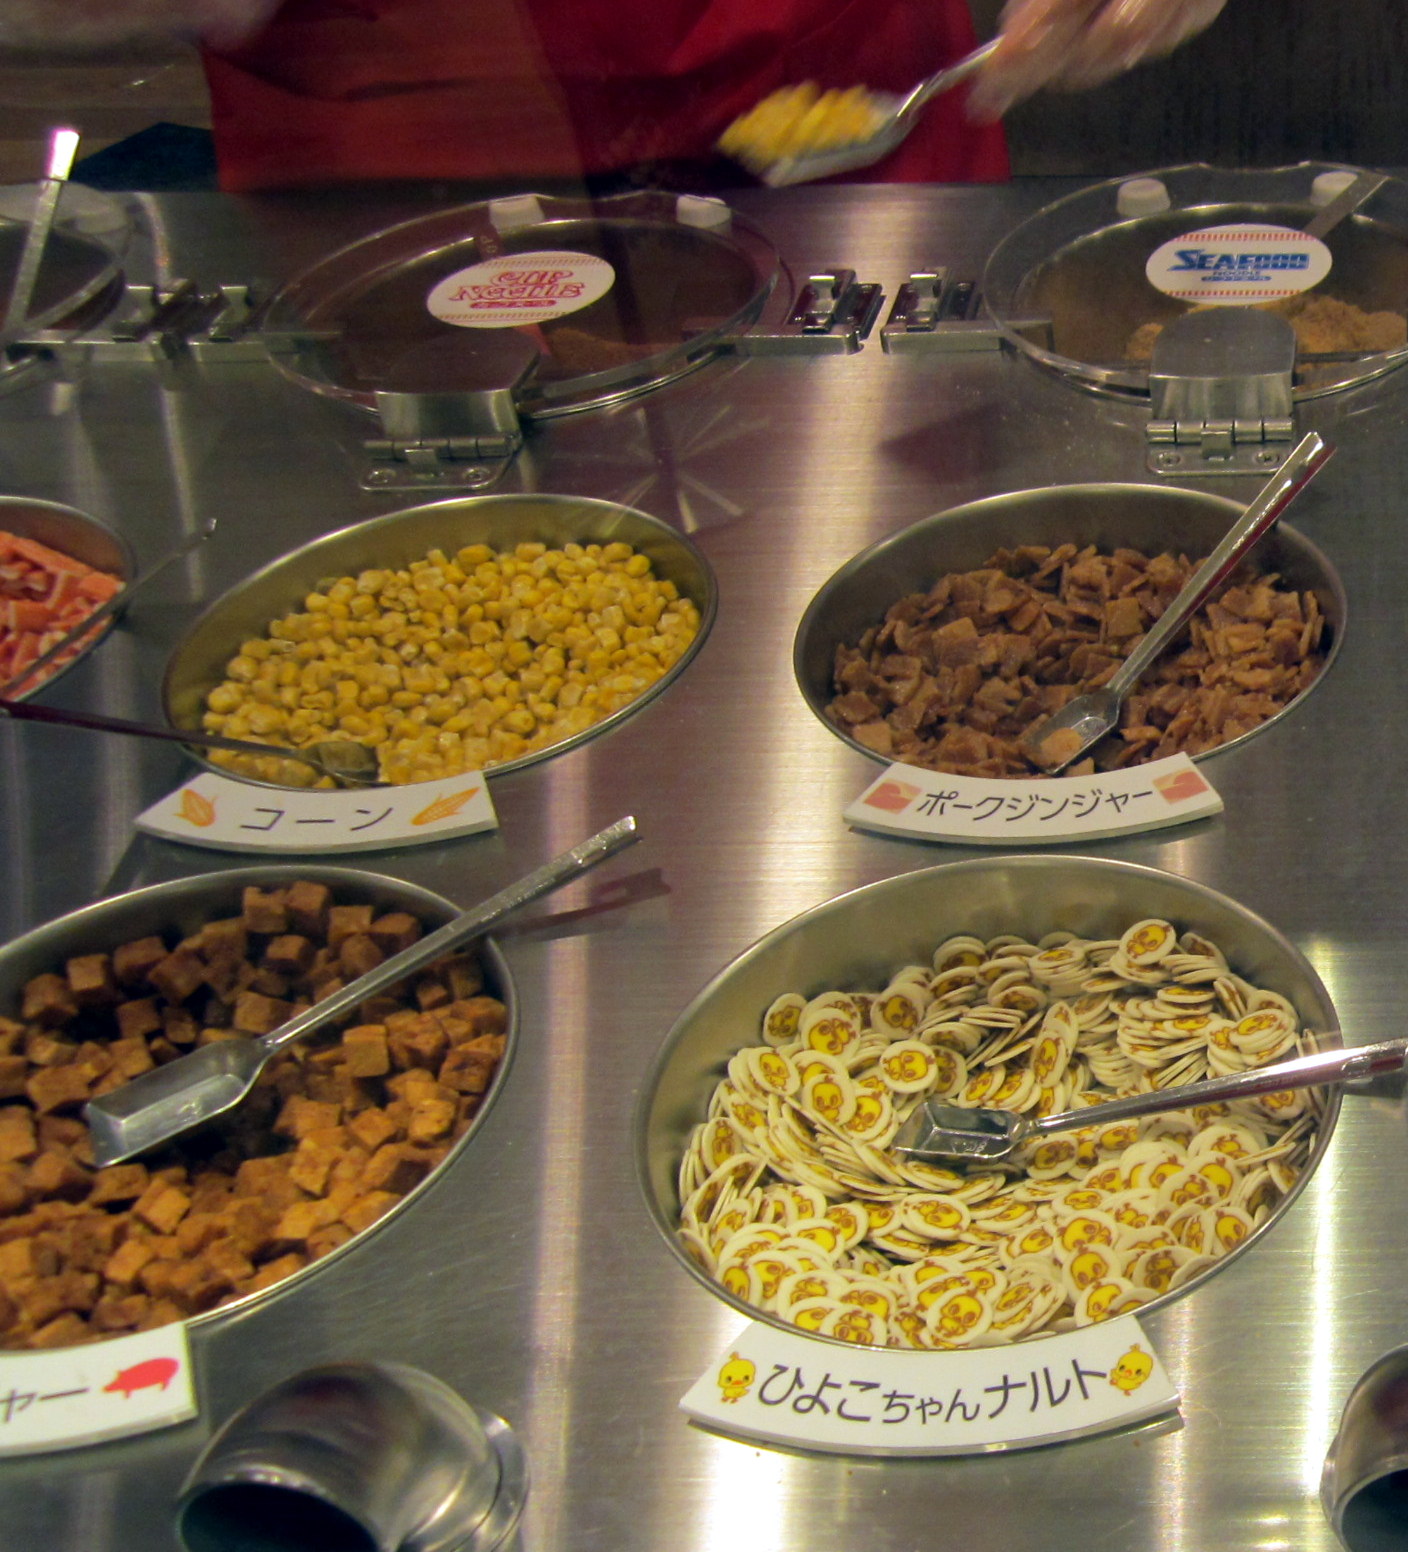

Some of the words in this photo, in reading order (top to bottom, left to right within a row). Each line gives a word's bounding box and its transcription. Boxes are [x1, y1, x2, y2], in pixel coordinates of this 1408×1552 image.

[1166, 248, 1310, 272] SEAFOOD
[240, 807, 393, 831] コーン
[916, 790, 1153, 822] ポークジンジャー
[758, 1358, 1107, 1425] ひよこちゃんナルト
